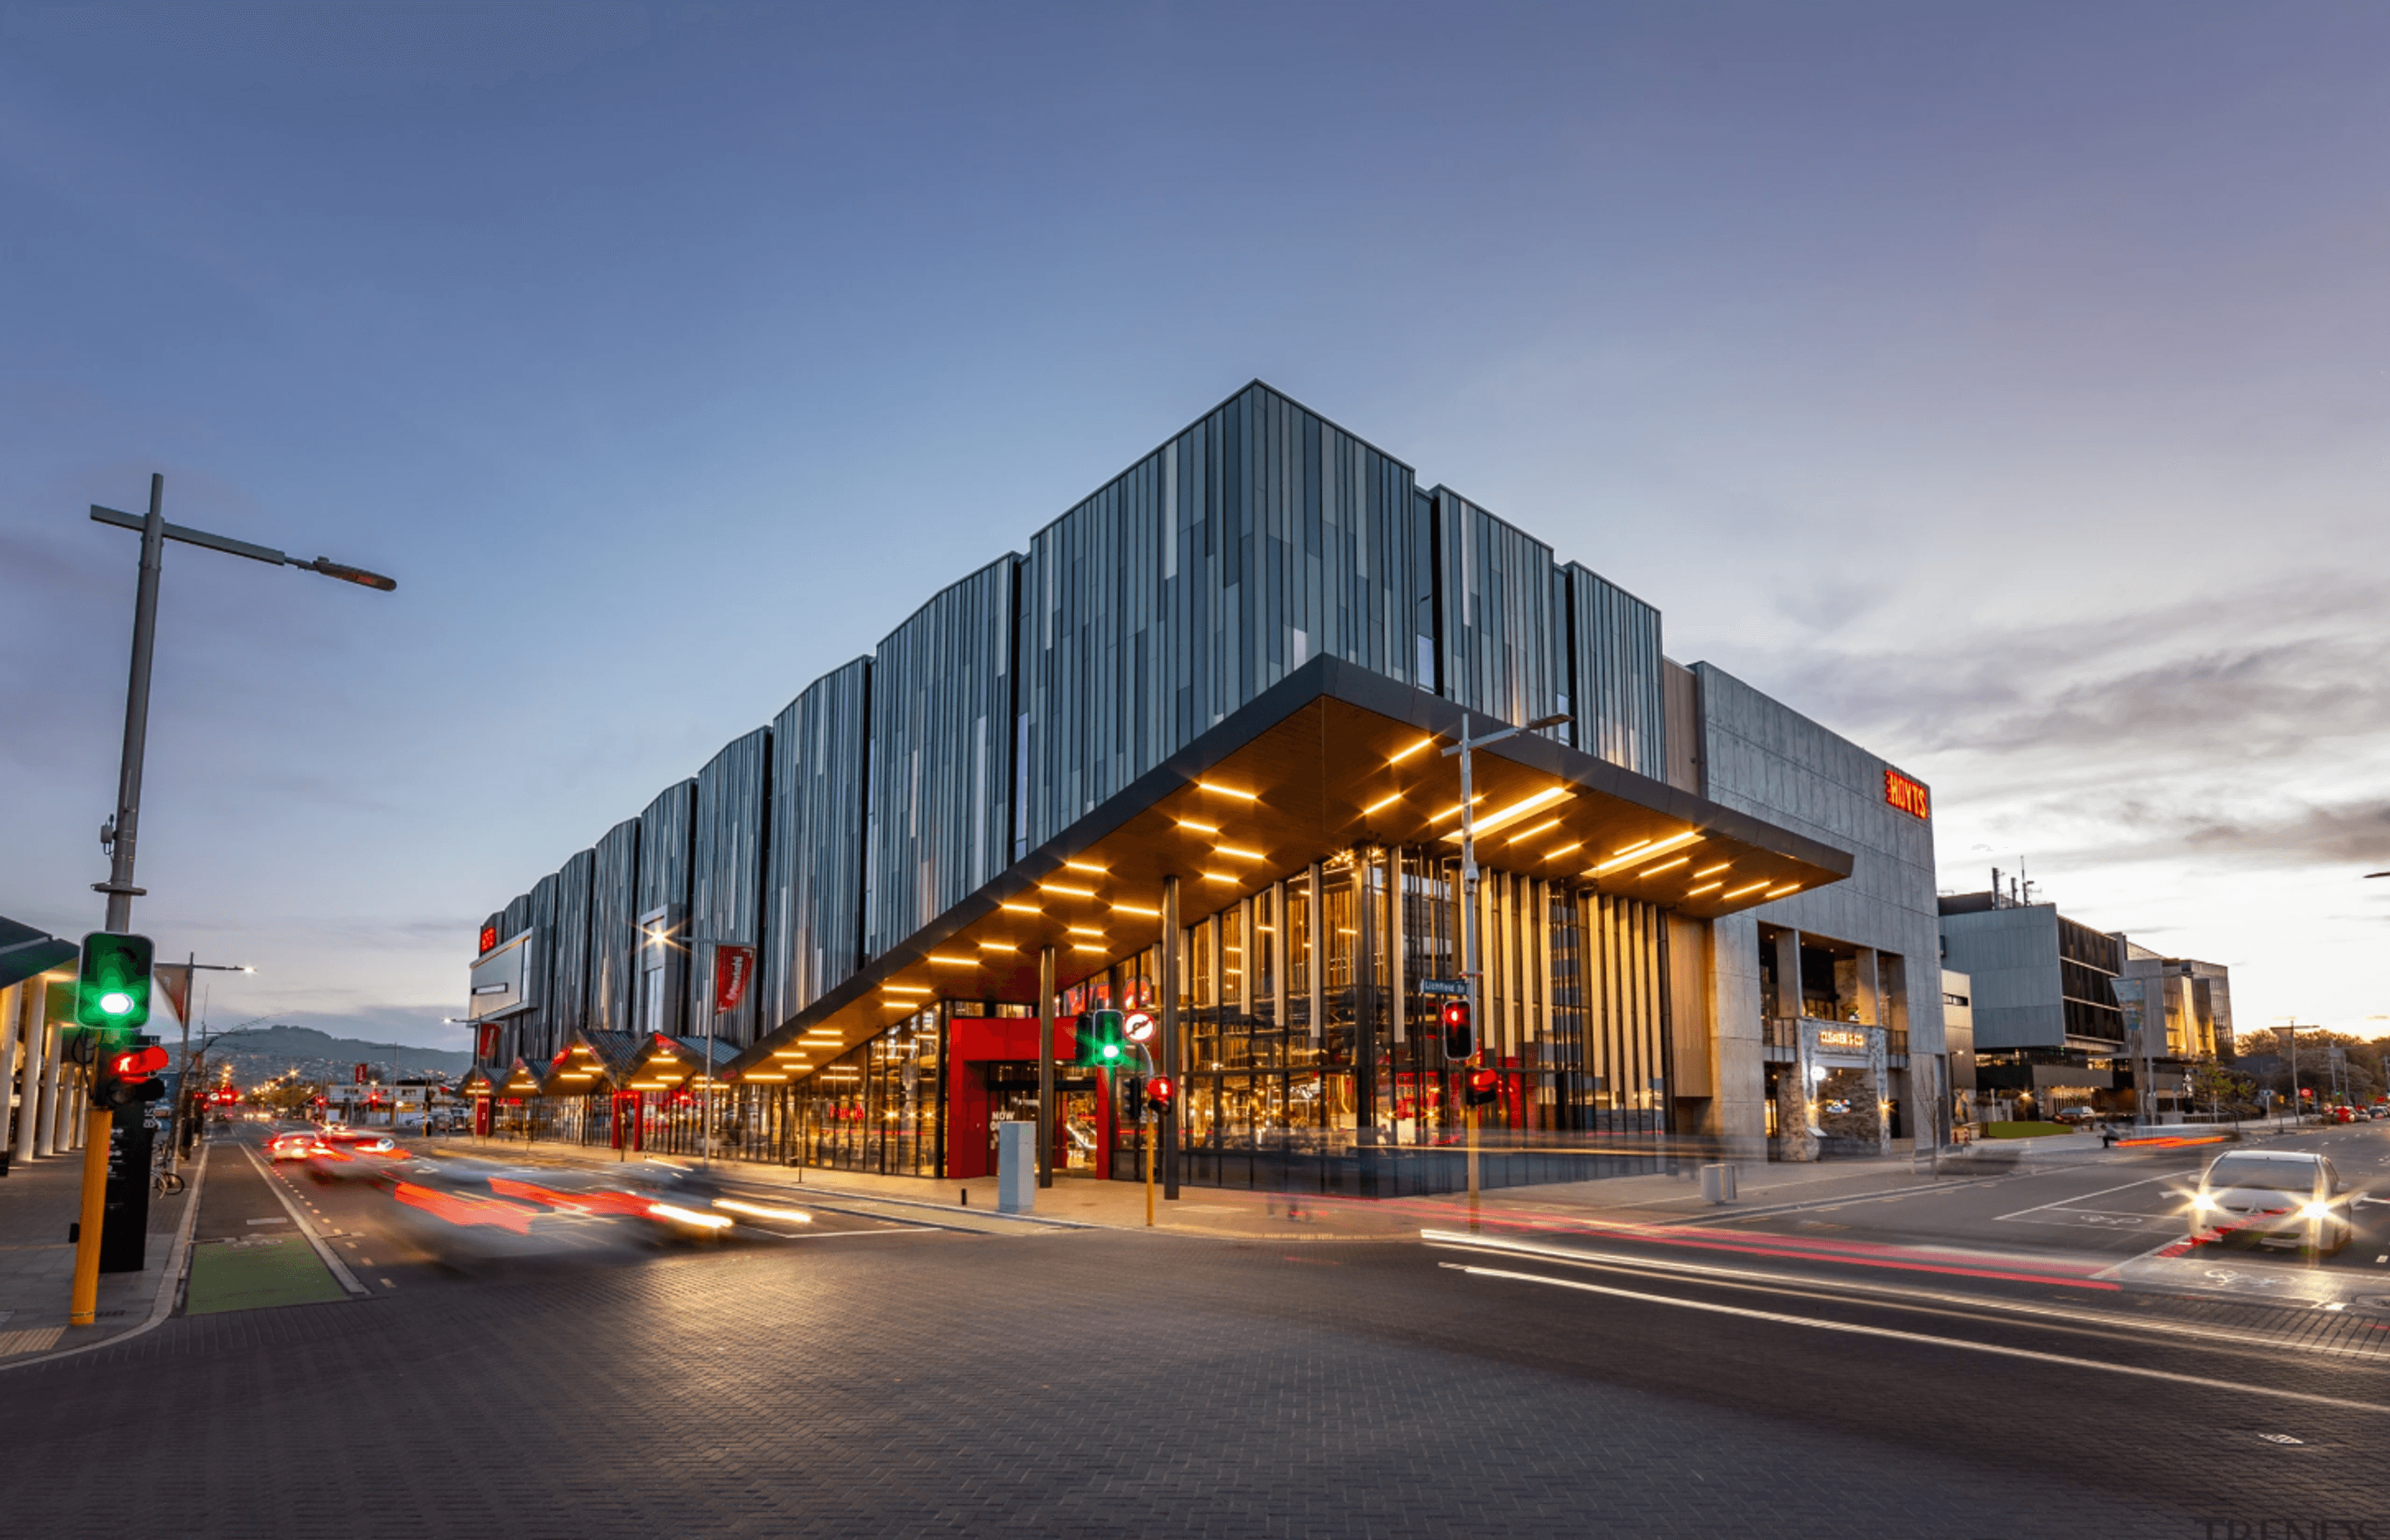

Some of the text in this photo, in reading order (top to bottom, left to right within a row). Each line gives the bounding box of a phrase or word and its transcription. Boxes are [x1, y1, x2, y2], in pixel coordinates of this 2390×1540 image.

[1890, 772, 1926, 819] HOYTS
[143, 1107, 156, 1128] BUS
[991, 1111, 1015, 1121] NOW
